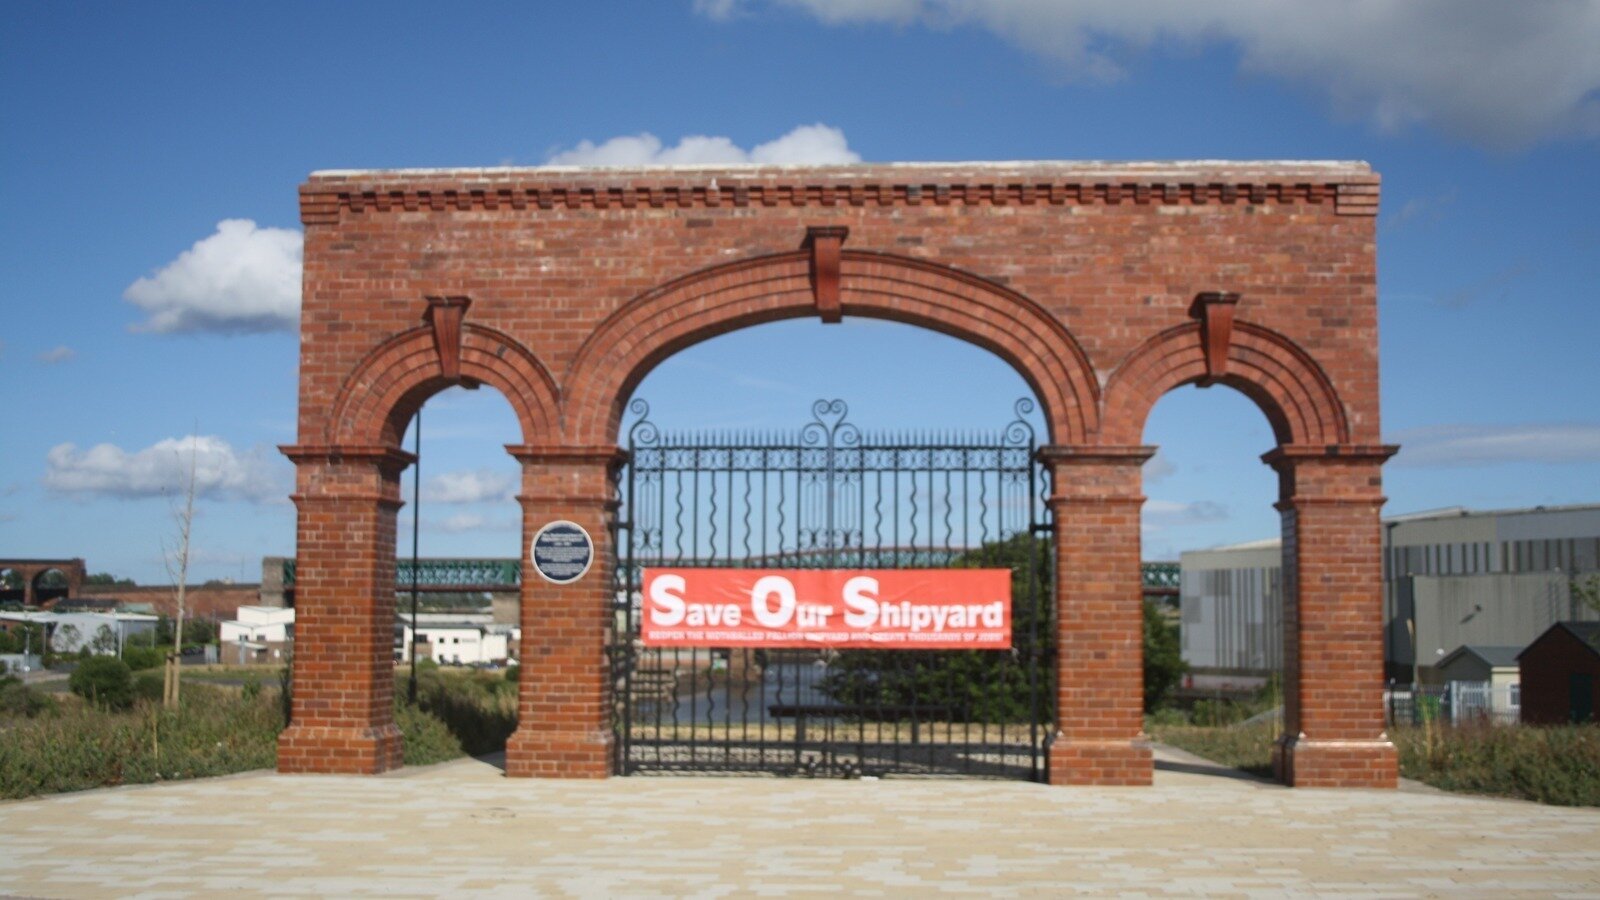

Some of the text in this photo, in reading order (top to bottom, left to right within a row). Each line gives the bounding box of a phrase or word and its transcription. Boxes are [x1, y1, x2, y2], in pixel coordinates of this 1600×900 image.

[650, 574, 1004, 632] Save Our Shipyard
